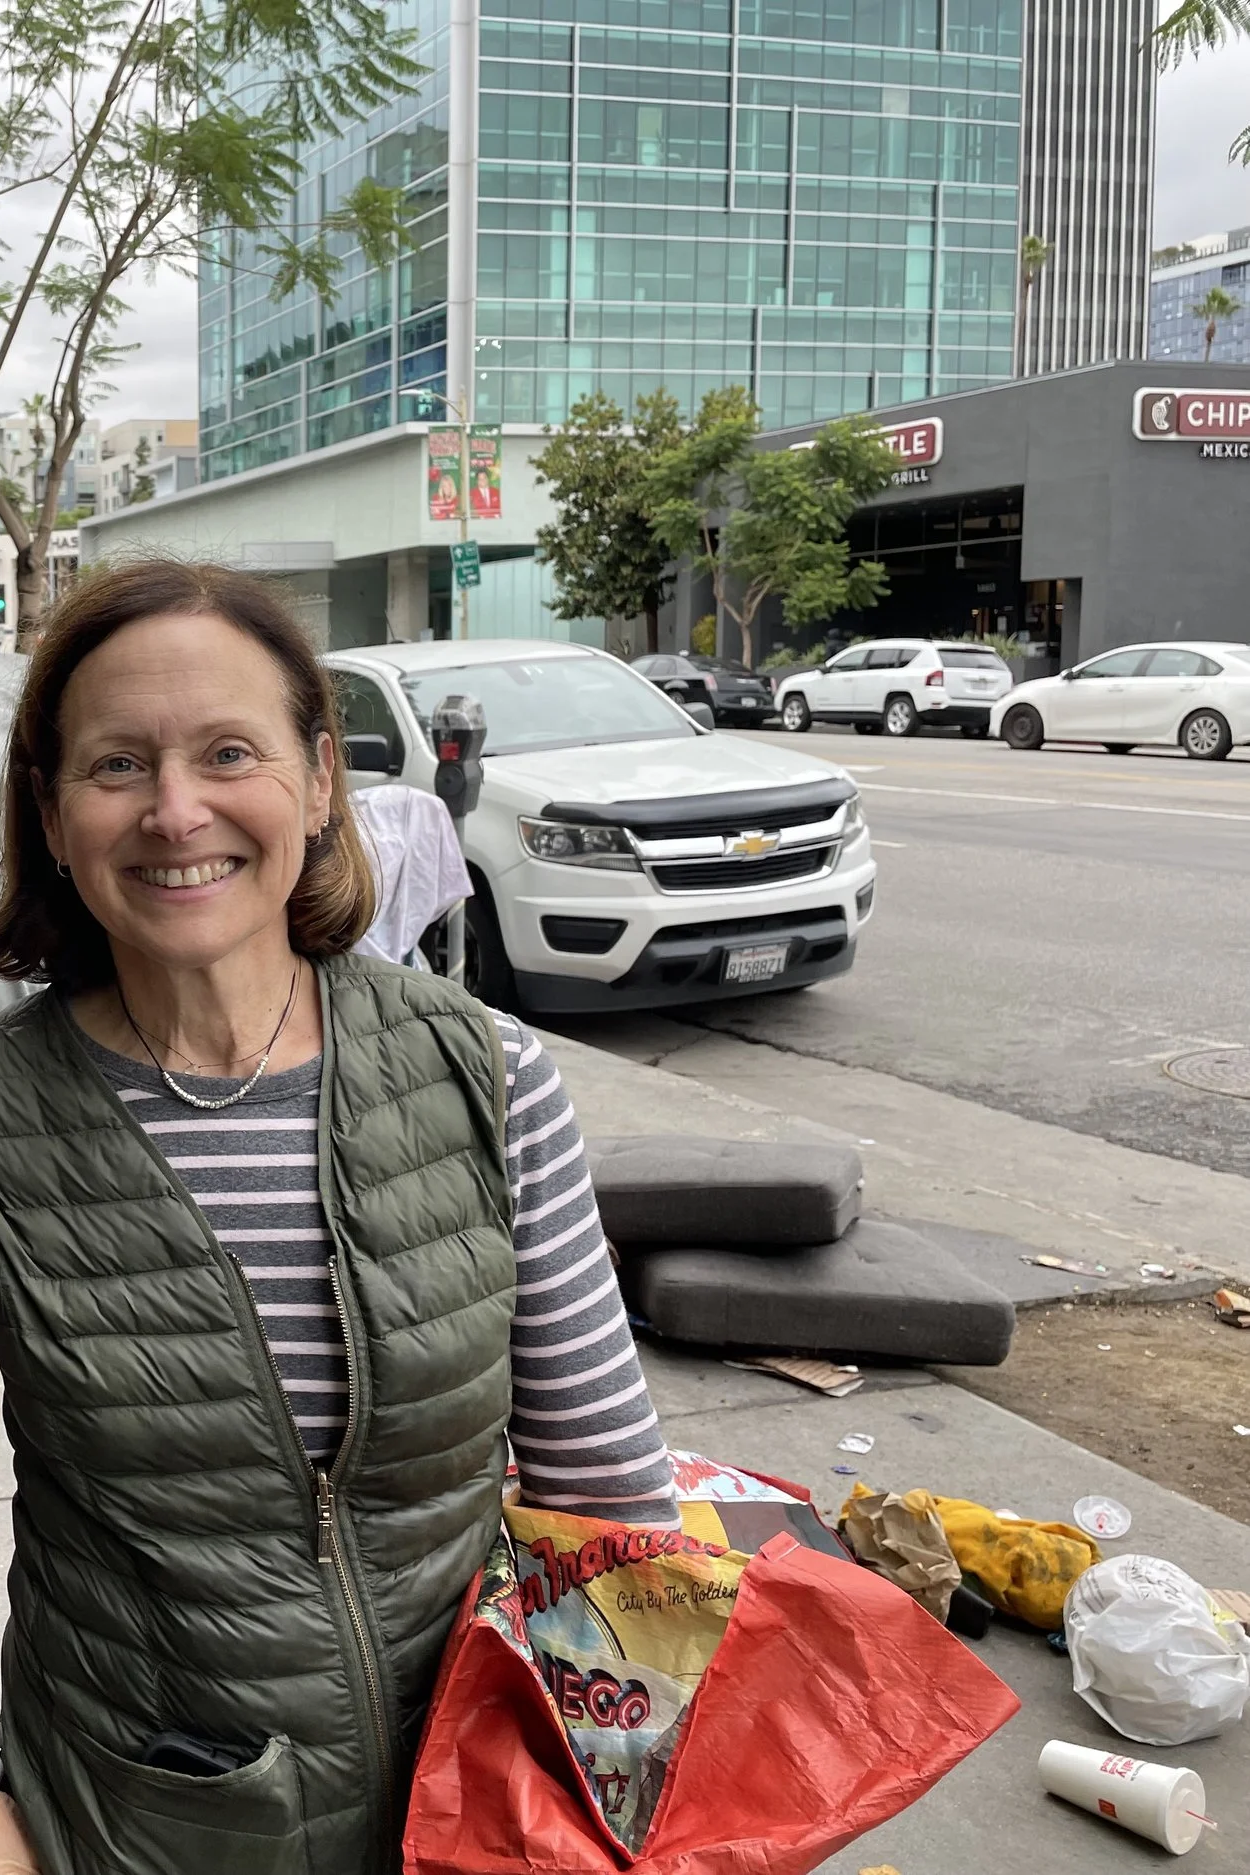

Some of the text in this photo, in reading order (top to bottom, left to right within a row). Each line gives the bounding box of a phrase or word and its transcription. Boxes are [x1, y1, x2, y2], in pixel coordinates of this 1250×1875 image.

[1203, 443, 1250, 458] MEXIC
[616, 1590, 644, 1615] City
[645, 1590, 662, 1611] By
[664, 1585, 687, 1606] The
